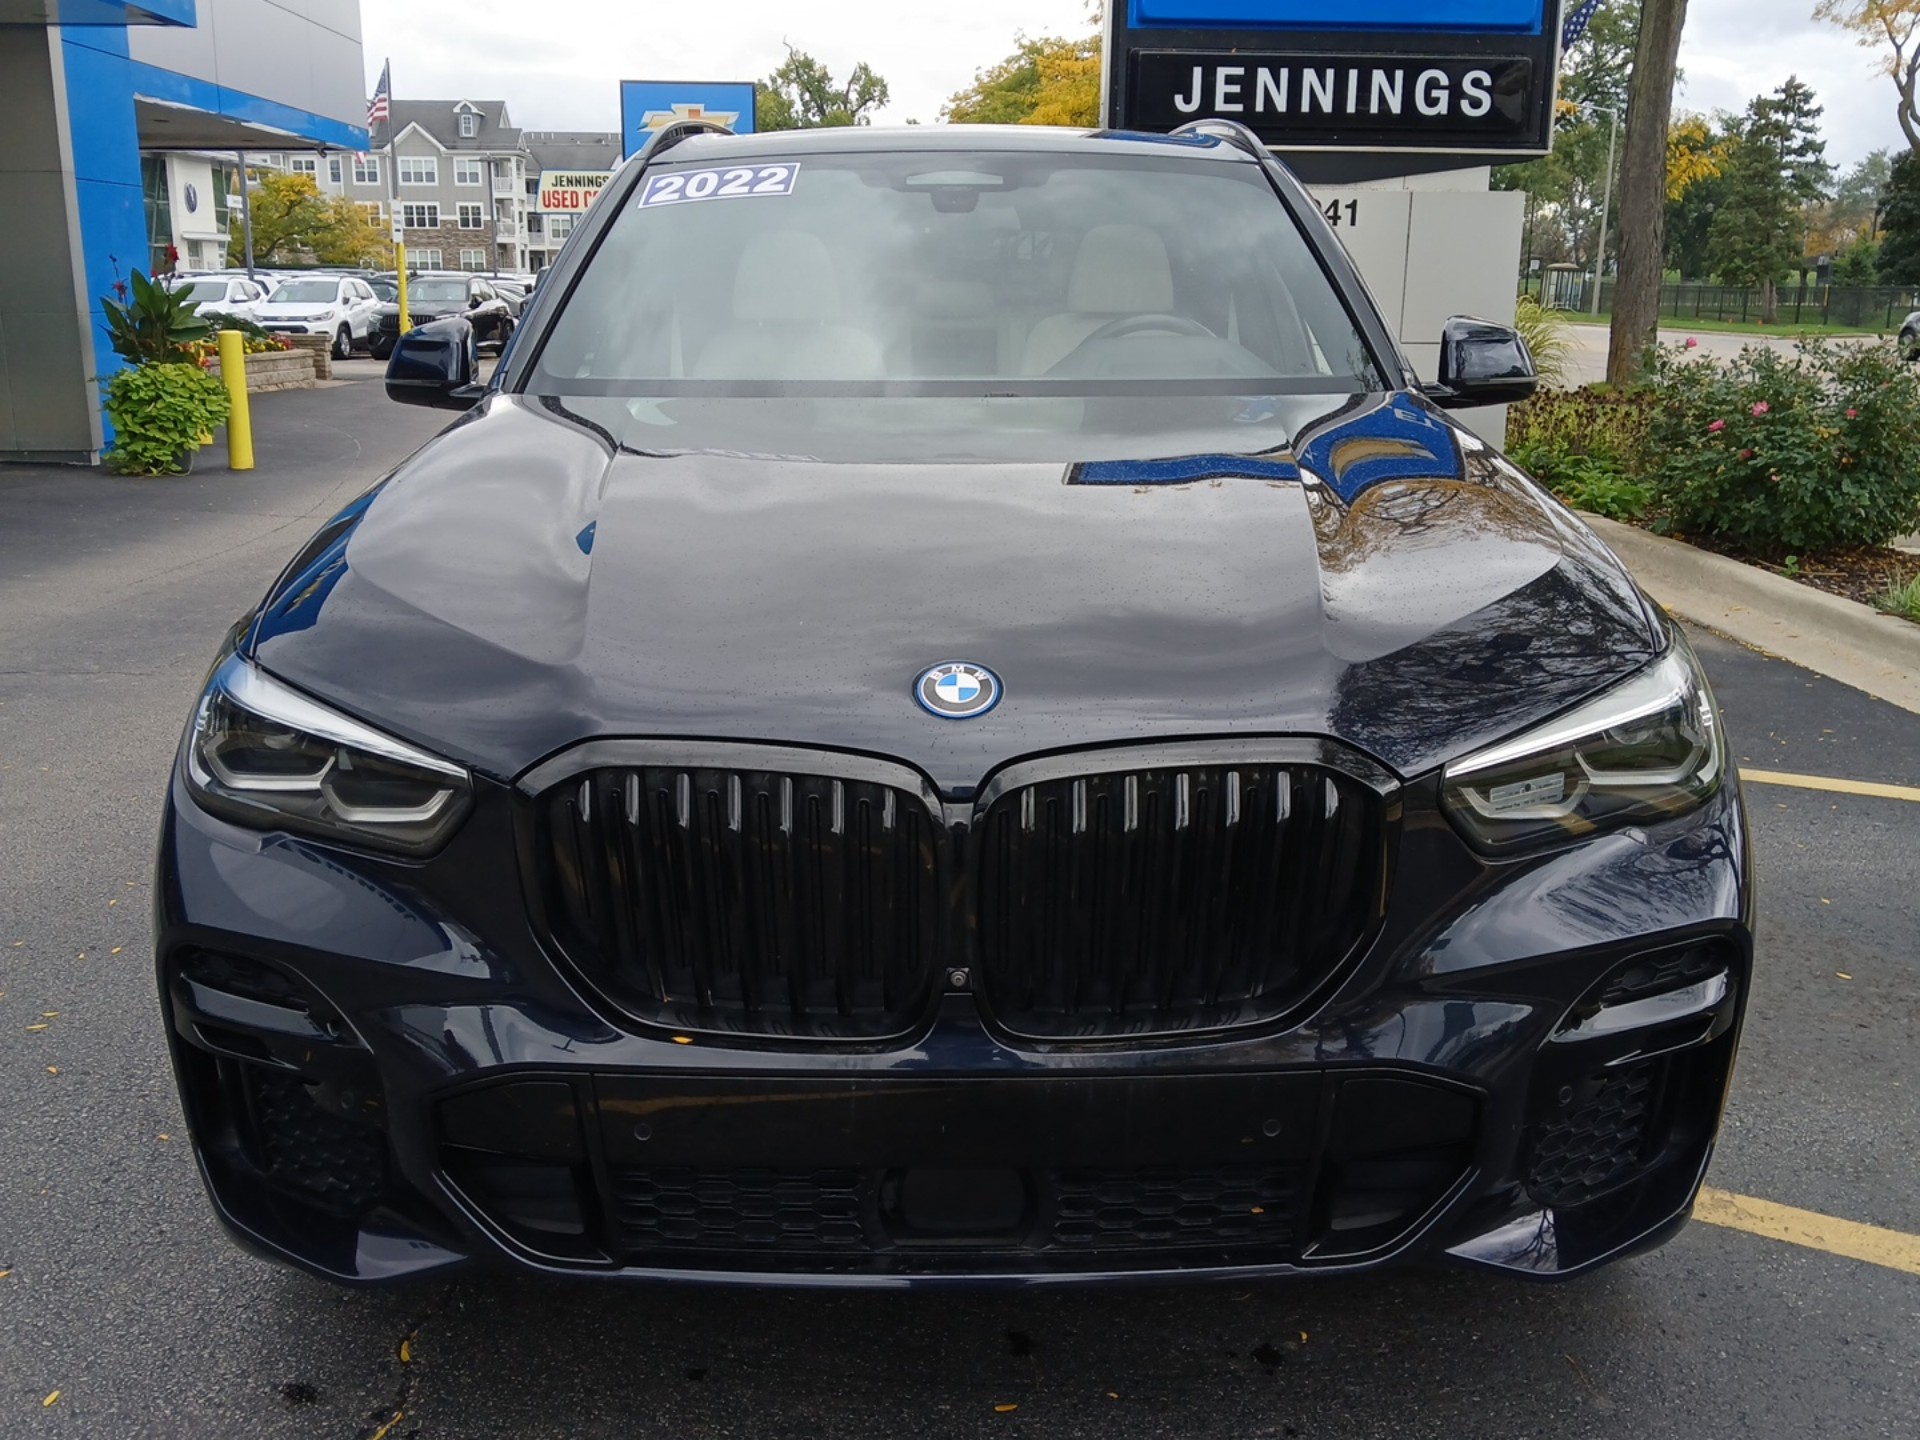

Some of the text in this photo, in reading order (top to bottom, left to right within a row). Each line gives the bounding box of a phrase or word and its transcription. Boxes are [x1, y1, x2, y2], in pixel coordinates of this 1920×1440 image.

[1174, 66, 1492, 117] JENNINGS
[542, 190, 580, 209] USED
[648, 167, 789, 204] 2022
[928, 665, 989, 681] BMW
